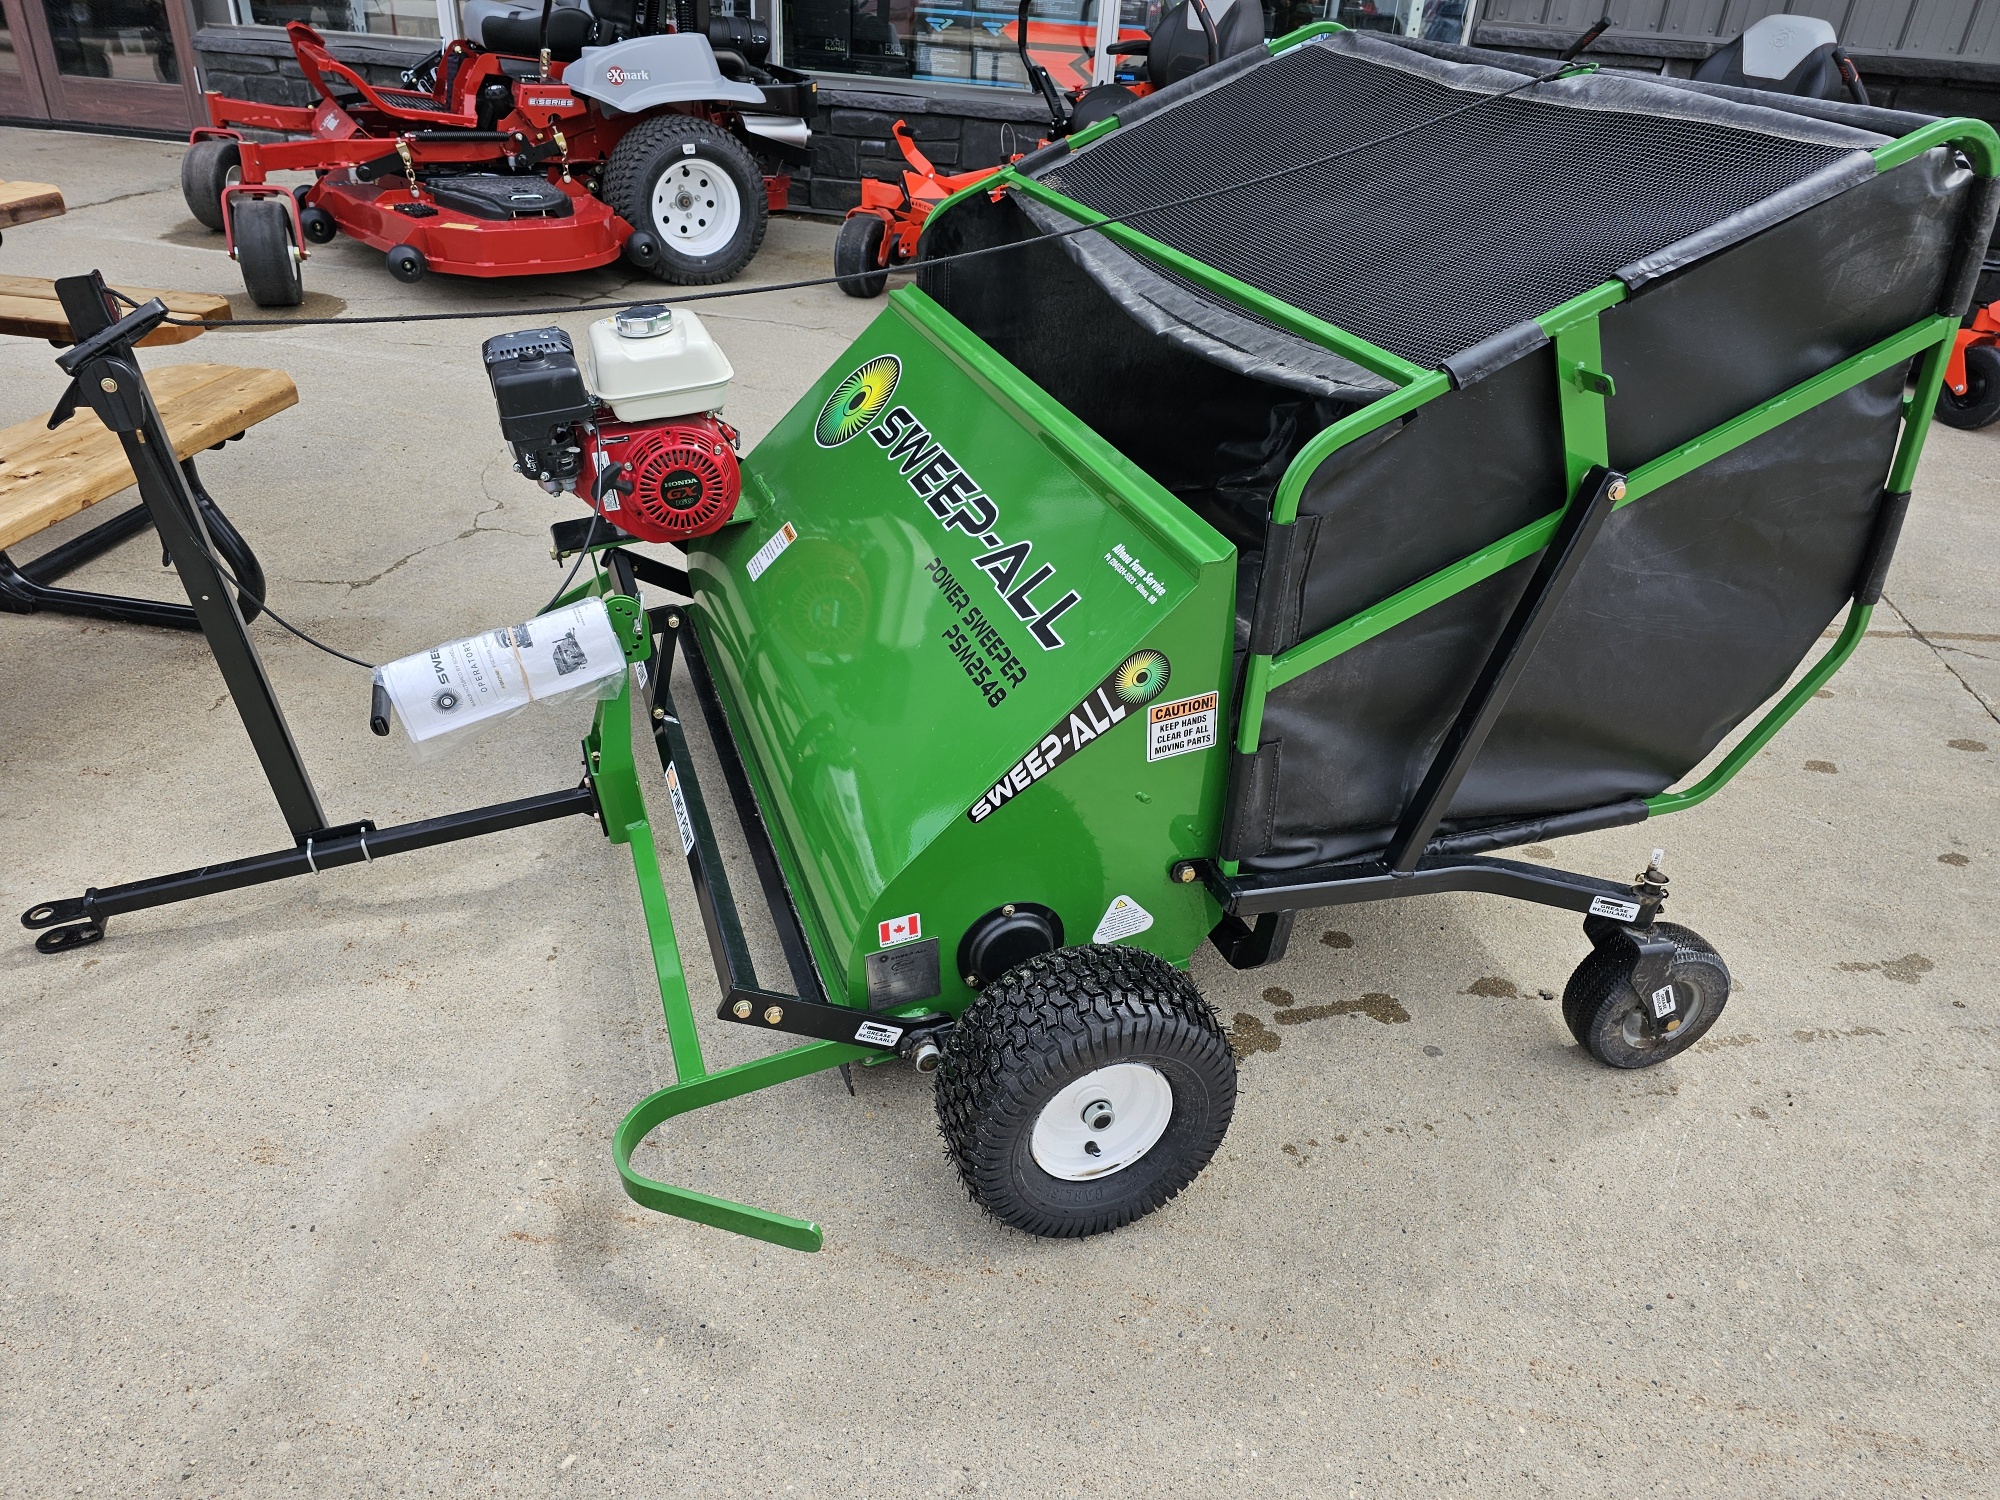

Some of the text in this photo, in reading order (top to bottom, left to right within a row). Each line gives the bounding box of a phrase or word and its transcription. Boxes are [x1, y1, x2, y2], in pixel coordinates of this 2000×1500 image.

[664, 478, 699, 488] HONDA
[667, 485, 697, 500] GX
[868, 406, 1082, 651] SWEEP-ALL
[1111, 543, 1167, 596] Altona Farm Service
[925, 557, 1028, 689] POWER SWEEPER
[942, 624, 1007, 708] PSM2548
[1156, 697, 1213, 720] CAUTION!
[1160, 715, 1207, 733] KEEP HANDS
[1154, 734, 1211, 755] MOVING PARTS
[1157, 725, 1209, 744] CLEAR OF ALL
[971, 687, 1126, 822] SWEEP-ALL
[681, 816, 693, 849] POINT
[1592, 906, 1634, 919] REGULARLY
[1600, 905, 1629, 914] GREASE
[858, 1033, 896, 1044] REGULARLY
[866, 1030, 892, 1039] GREASE
